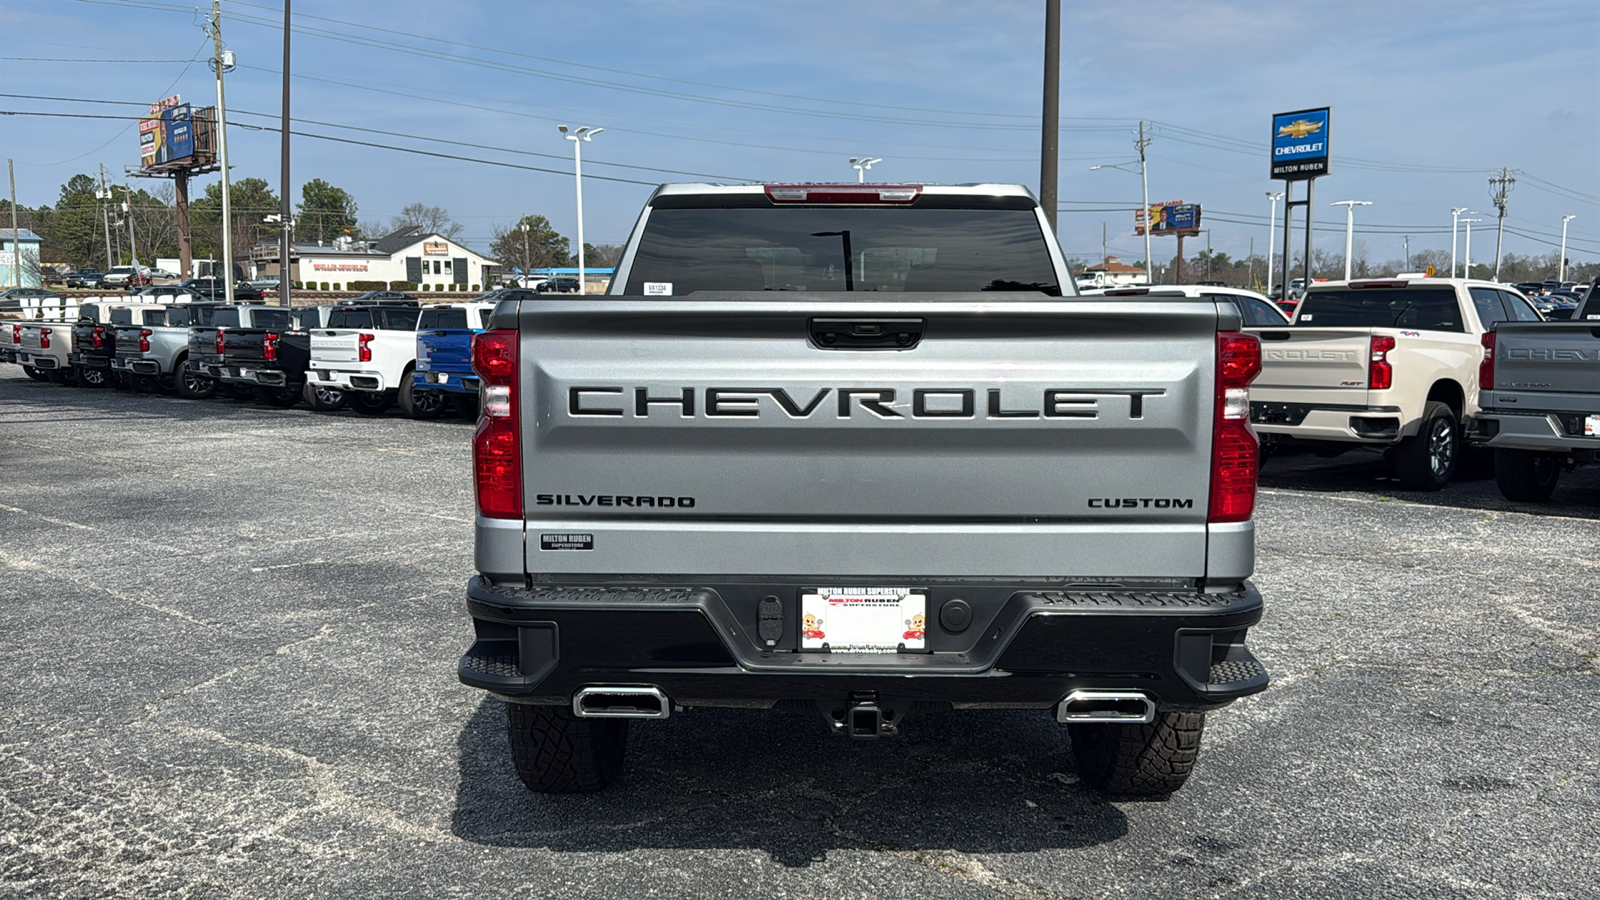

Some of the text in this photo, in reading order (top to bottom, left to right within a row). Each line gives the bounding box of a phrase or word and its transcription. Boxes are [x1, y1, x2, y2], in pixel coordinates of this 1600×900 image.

[1275, 143, 1323, 155] CHEVROLET
[1274, 163, 1323, 174] MILTON RUBEN
[1263, 349, 1355, 361] ROLET
[567, 385, 1167, 420] CHEVROLET
[536, 494, 696, 508] SILVERADO
[1088, 498, 1193, 509] CUSTOM
[542, 534, 592, 543] MILTON RUBEN
[817, 587, 911, 596] MILTON RUBEN SUPERSTORE
